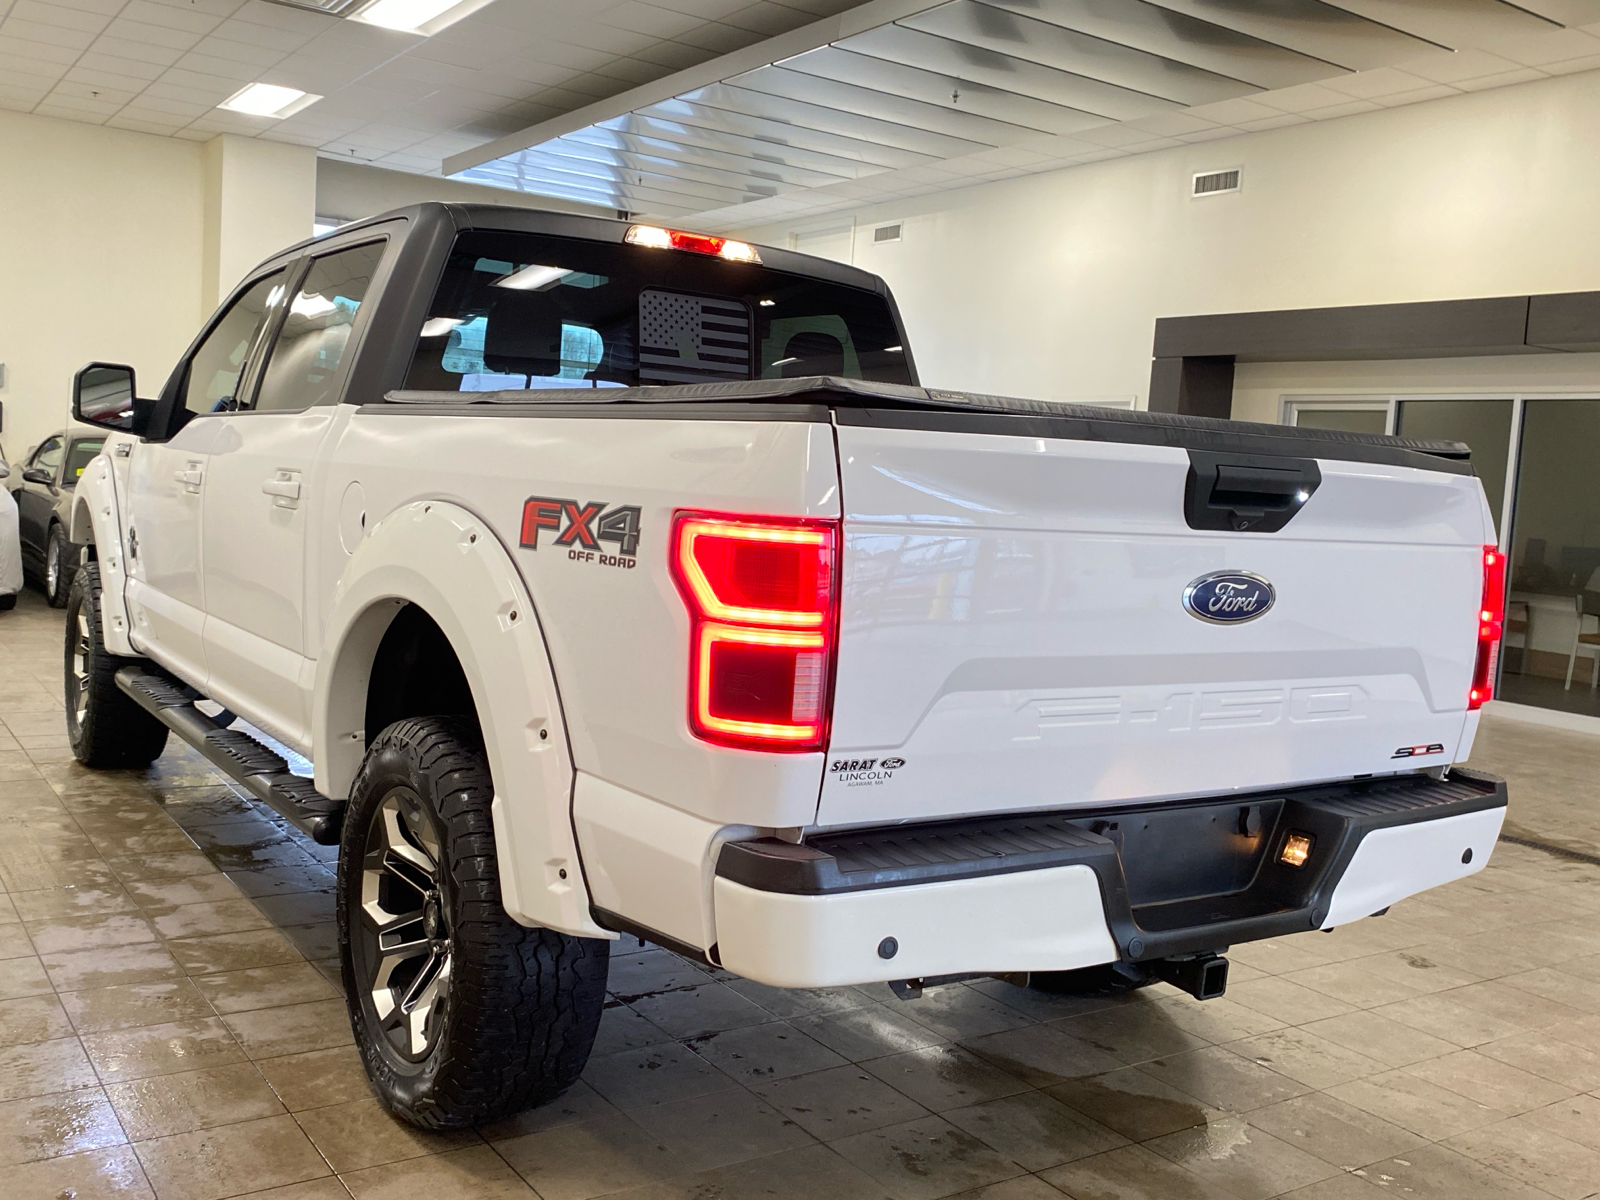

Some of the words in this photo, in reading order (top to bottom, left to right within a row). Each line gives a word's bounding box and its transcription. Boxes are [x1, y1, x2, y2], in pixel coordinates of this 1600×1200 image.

[519, 495, 642, 557] FX4
[568, 549, 594, 562] OFF
[599, 554, 636, 569] ROAD
[1208, 582, 1260, 612] Ford
[1012, 684, 1369, 741] F-150
[830, 759, 878, 773] SARAT
[839, 771, 892, 781] LINCOLN
